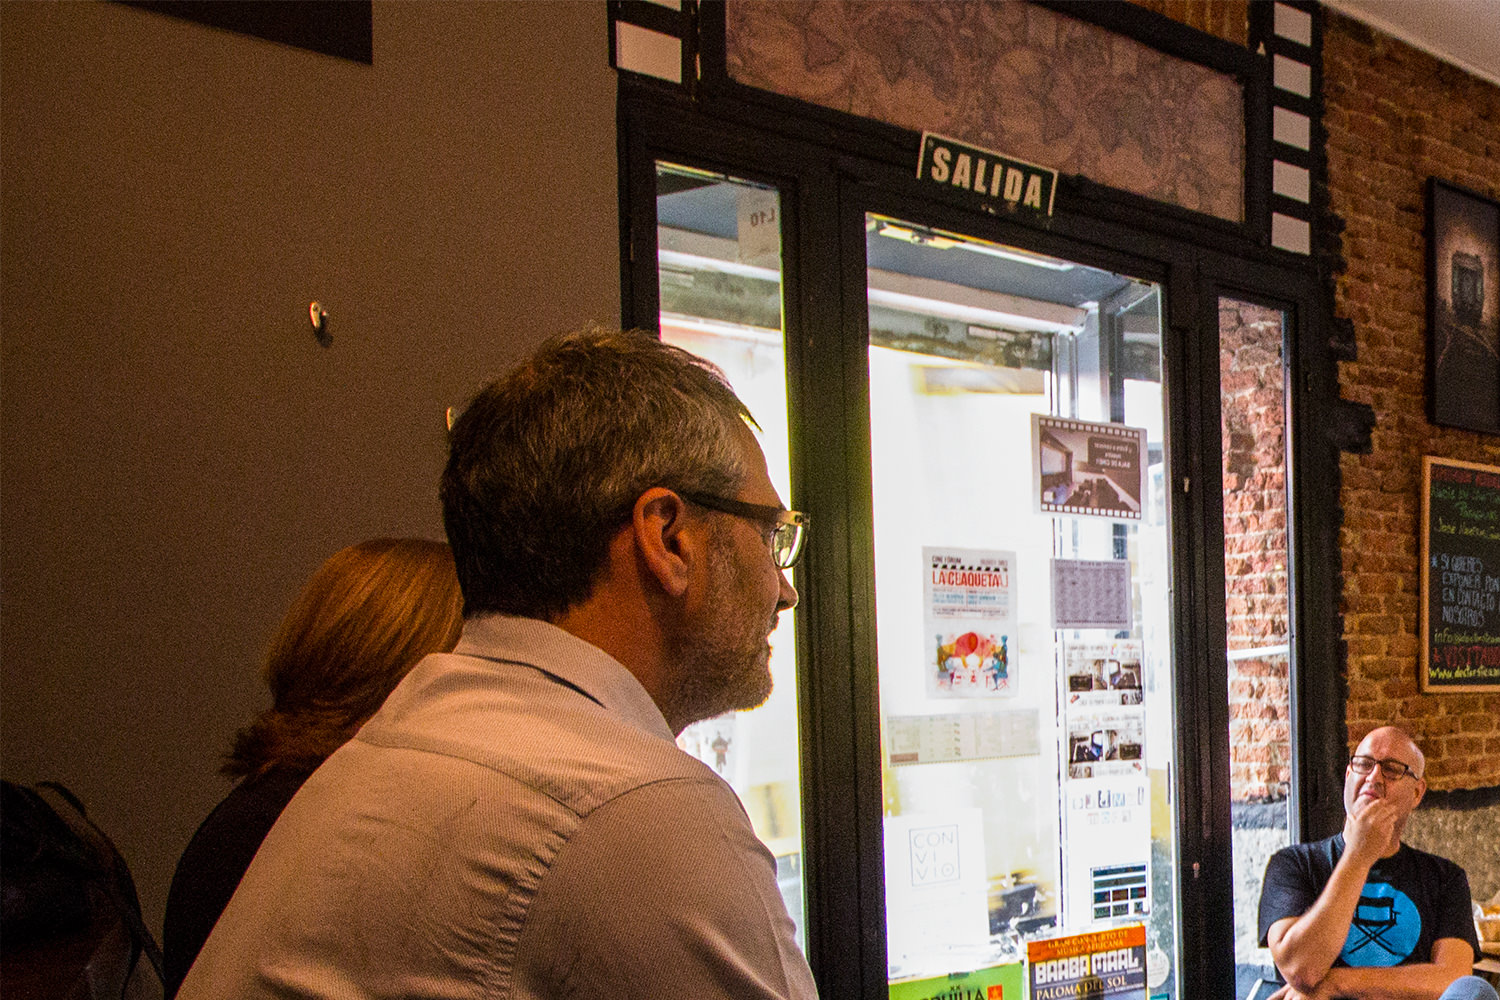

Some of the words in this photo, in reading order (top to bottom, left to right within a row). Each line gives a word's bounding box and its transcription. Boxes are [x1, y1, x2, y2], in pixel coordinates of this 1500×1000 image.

[931, 146, 1042, 209] SALIDA
[1035, 954, 1091, 985] BAABA
[1091, 947, 1139, 976] MAAL
[1036, 983, 1081, 1000] PALOMA
[1107, 975, 1128, 989] SOL
